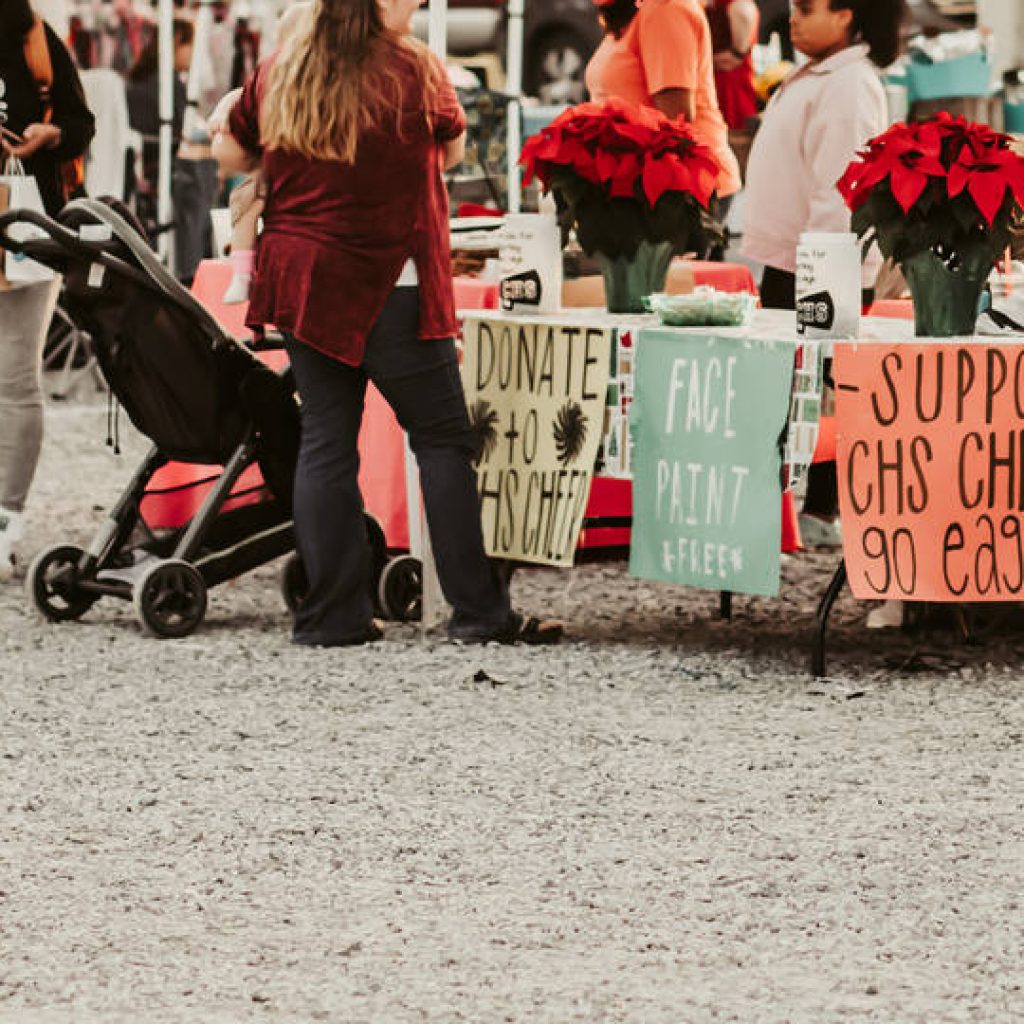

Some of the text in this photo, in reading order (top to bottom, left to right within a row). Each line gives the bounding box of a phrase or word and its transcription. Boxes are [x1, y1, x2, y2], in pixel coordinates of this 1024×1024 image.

[477, 322, 603, 400] DONATE
[665, 356, 737, 439] FACE
[504, 409, 538, 464] to
[847, 435, 932, 515] CHS
[481, 469, 519, 552] HS
[656, 458, 750, 524] PAINT
[862, 527, 917, 595] go
